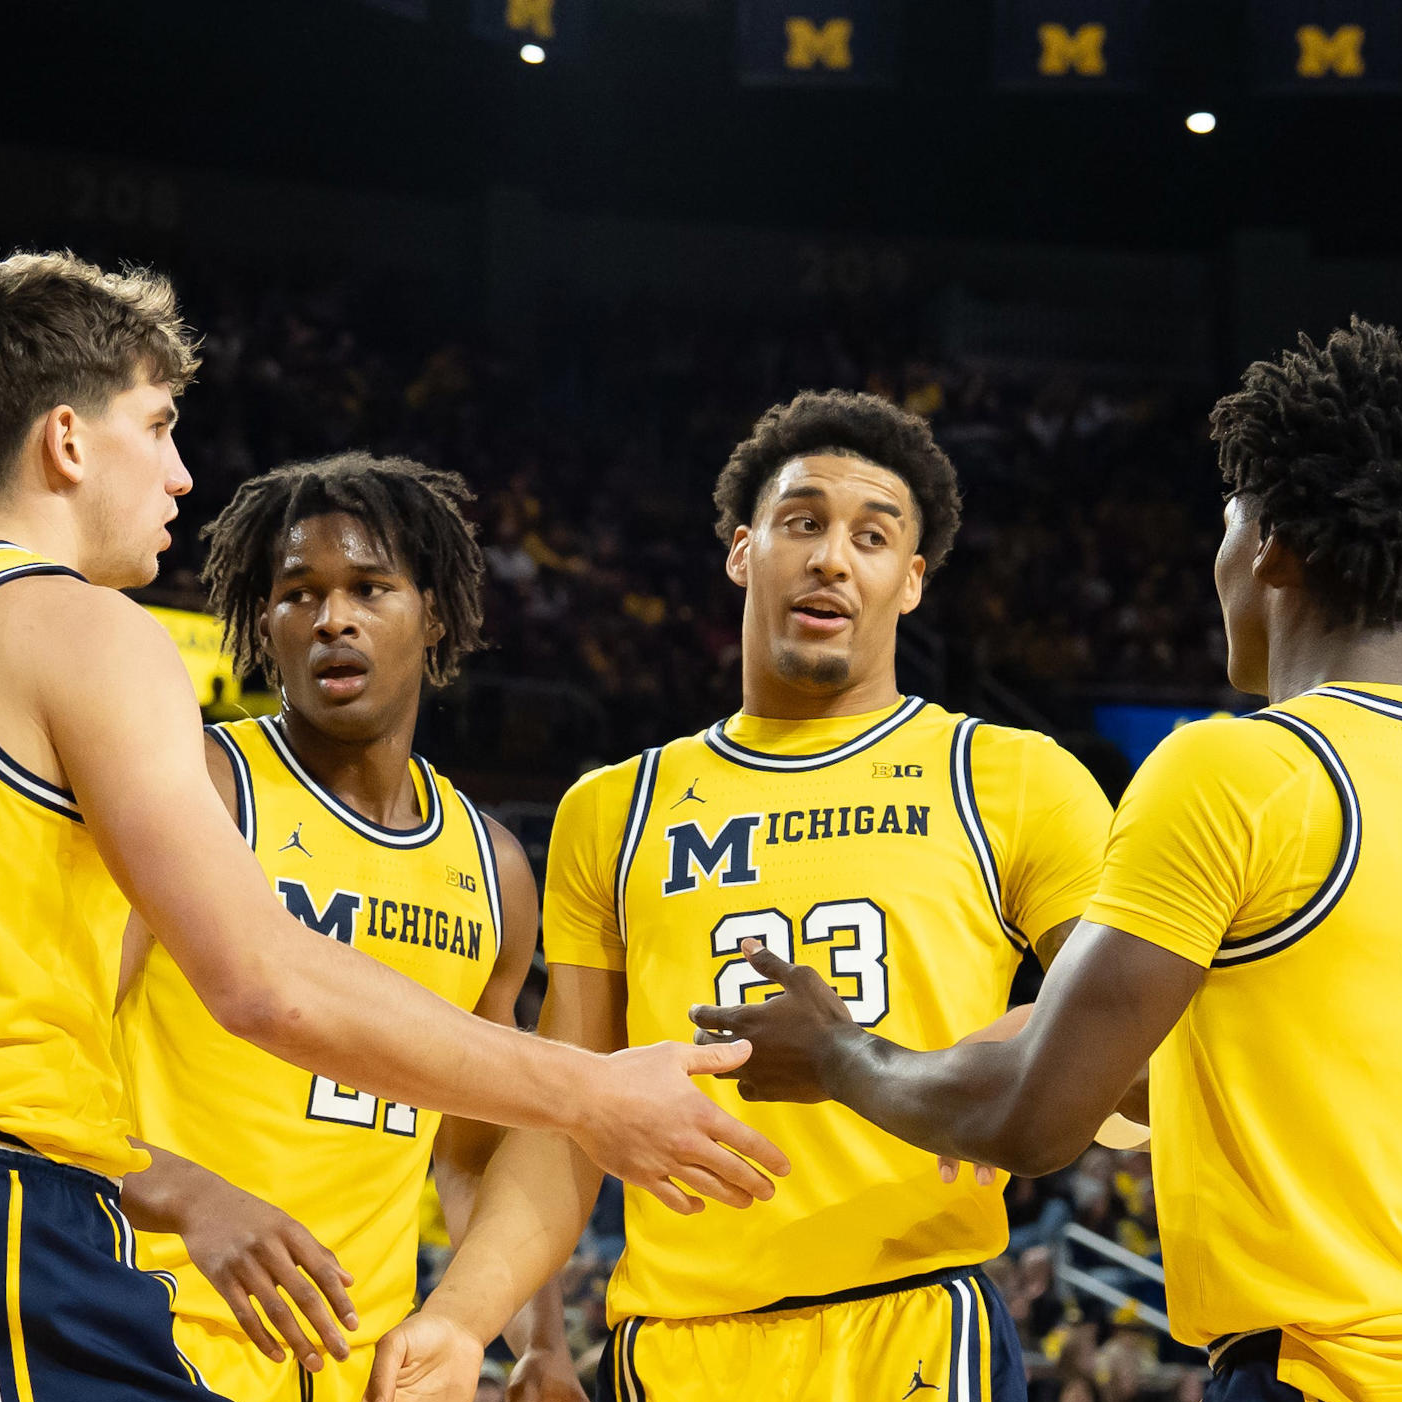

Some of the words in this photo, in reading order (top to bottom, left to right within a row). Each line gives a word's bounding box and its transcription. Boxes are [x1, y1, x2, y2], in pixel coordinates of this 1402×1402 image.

[784, 16, 853, 70] M
[1036, 22, 1106, 76] M
[1295, 24, 1365, 78] M
[661, 805, 930, 898] MICHIGAN
[710, 897, 889, 1028] 23
